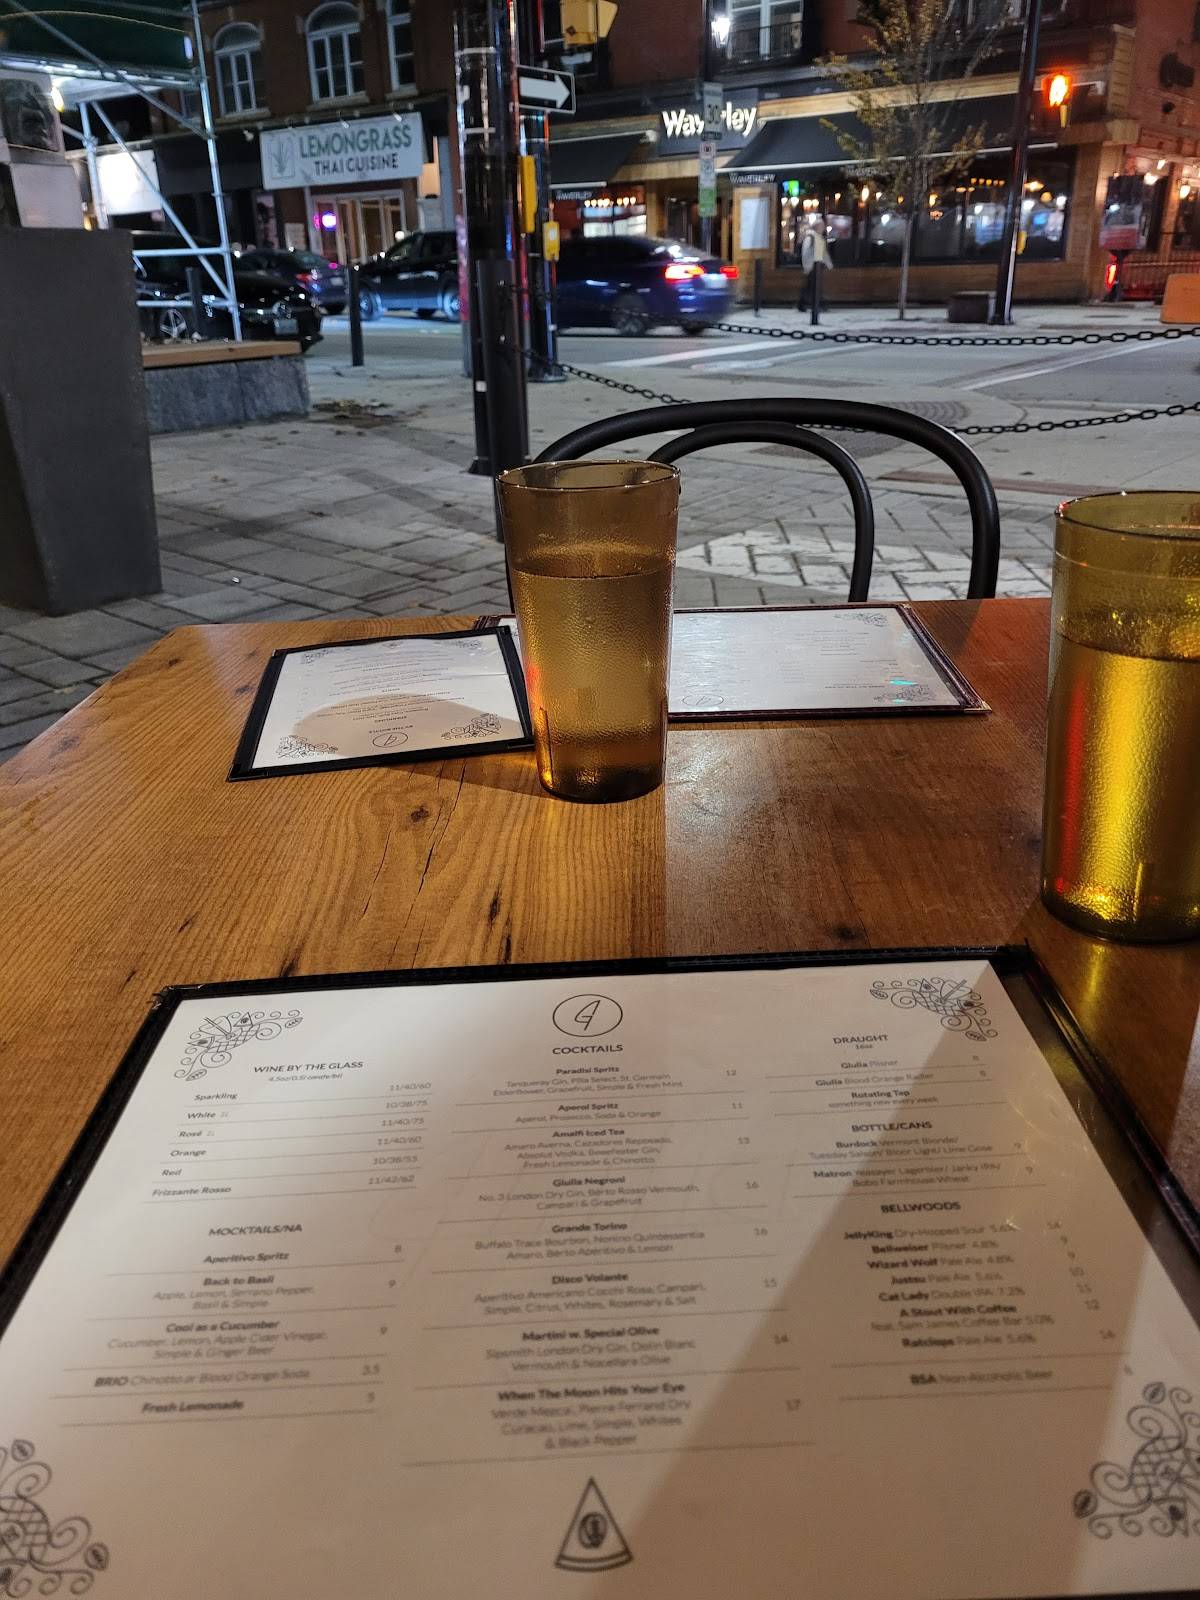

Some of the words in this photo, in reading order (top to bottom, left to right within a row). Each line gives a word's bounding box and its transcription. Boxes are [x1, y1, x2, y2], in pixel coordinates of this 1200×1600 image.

[662, 102, 757, 137] Wavley
[300, 125, 412, 158] LEMONGRASS
[315, 161, 343, 176] THAI
[346, 153, 398, 173] CUISINE
[833, 1034, 888, 1044] DRAUGHT
[552, 1044, 623, 1055] COCKTAILS
[329, 1061, 364, 1069] GLASS
[841, 1060, 867, 1069] Giulia
[596, 1066, 619, 1074] Spritz
[815, 1078, 842, 1087] Giulia
[872, 1074, 904, 1083] Orange
[194, 1093, 237, 1101] Sparkling
[851, 1090, 891, 1099] Rotating
[558, 1103, 589, 1111] Aperol
[592, 1102, 618, 1111] Spritz
[828, 1101, 872, 1109] something
[595, 1112, 617, 1120] Soda
[628, 1110, 661, 1119] Orange
[852, 1121, 932, 1133] BOTTLE/CANS
[836, 1140, 878, 1148] Burdock
[603, 1157, 610, 1165] &
[161, 1168, 182, 1176] Red
[814, 1170, 851, 1178] Matron
[553, 1177, 582, 1187] Giulia
[584, 1176, 625, 1186] Negroni
[152, 1188, 199, 1196] Frizzante
[507, 1192, 543, 1200] London
[546, 1191, 563, 1200] Dry
[617, 1187, 647, 1195] Rosso
[537, 1200, 578, 1210] Campari
[581, 1199, 589, 1207] &
[591, 1197, 642, 1208] Grapefruit
[881, 1202, 961, 1214] BELLWOODS
[209, 1224, 303, 1236] MOCKTAILS/NA
[552, 1224, 590, 1233] Grande
[594, 1223, 627, 1231] Torino
[515, 1239, 542, 1248] Trace
[628, 1245, 636, 1253] &
[638, 1244, 673, 1253] Lemon
[204, 1254, 255, 1264] Aperitivo
[257, 1252, 289, 1262] Spritz
[867, 1259, 908, 1269] Wizard
[910, 1258, 938, 1268] Wolf
[204, 1276, 230, 1286] Back
[234, 1277, 245, 1286] to
[248, 1276, 274, 1286] Basil
[552, 1274, 582, 1284] Disco
[585, 1272, 628, 1282] Volante
[528, 1290, 584, 1300] Americano
[879, 1292, 900, 1301] Cat
[902, 1291, 929, 1301] Lady
[221, 1300, 230, 1309] &
[609, 1298, 661, 1309] Rosemary
[664, 1298, 674, 1307] &
[677, 1296, 696, 1305] Salt
[900, 1308, 909, 1317] A
[911, 1307, 943, 1316] Stout
[945, 1305, 976, 1315] With
[978, 1304, 1017, 1313] Coffee
[166, 1322, 194, 1333] Cool
[196, 1324, 208, 1332] as
[220, 1320, 280, 1331] Cucumber
[522, 1330, 567, 1341] Martini
[584, 1327, 625, 1339] Special
[628, 1325, 659, 1336] Olive
[498, 1390, 535, 1401] When
[539, 1388, 561, 1399] The
[565, 1387, 600, 1398] Moon
[604, 1386, 628, 1396] Hits
[632, 1384, 659, 1394] Your
[663, 1382, 685, 1394] Eye
[142, 1402, 177, 1413] Fresh
[180, 1400, 244, 1412] Lemonade
